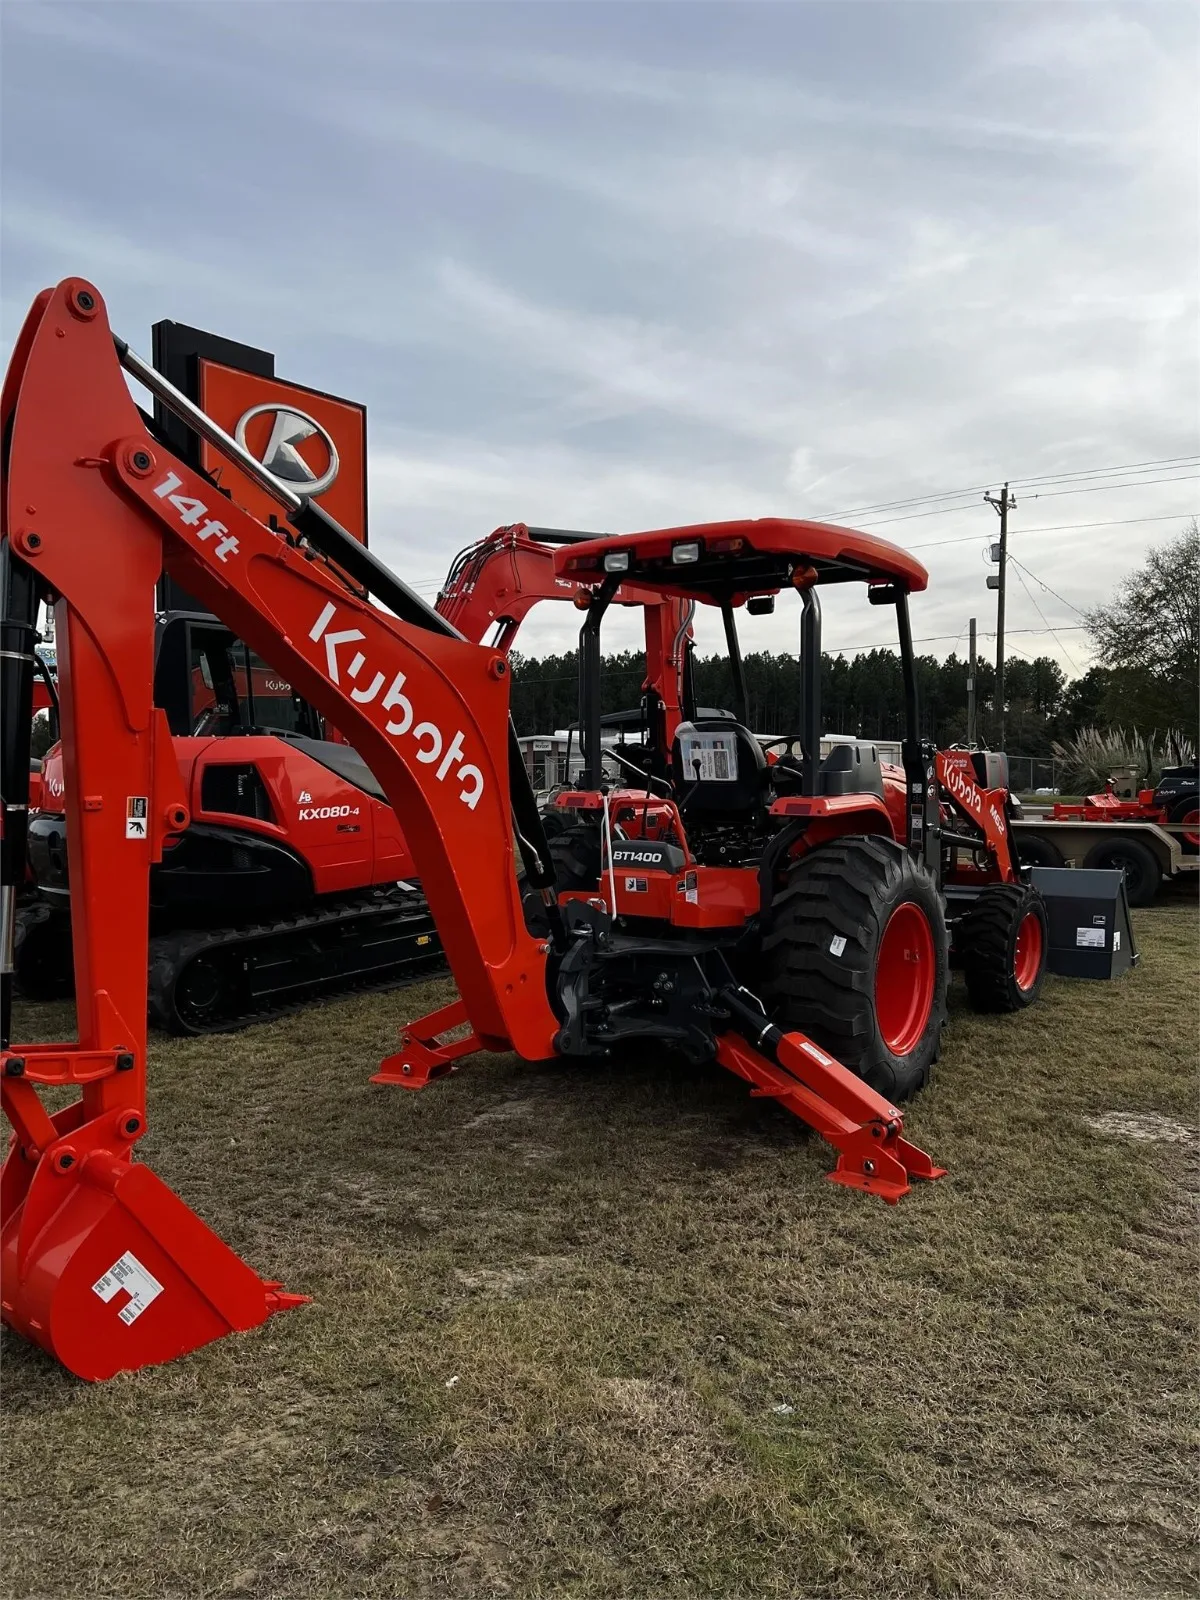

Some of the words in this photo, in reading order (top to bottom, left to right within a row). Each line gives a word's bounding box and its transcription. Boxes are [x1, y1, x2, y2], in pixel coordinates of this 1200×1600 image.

[153, 471, 240, 563] 14ft
[308, 601, 484, 811] Kubota
[298, 805, 360, 821] KX080-4
[943, 759, 983, 813] Kubota
[613, 850, 662, 863] BT1400
